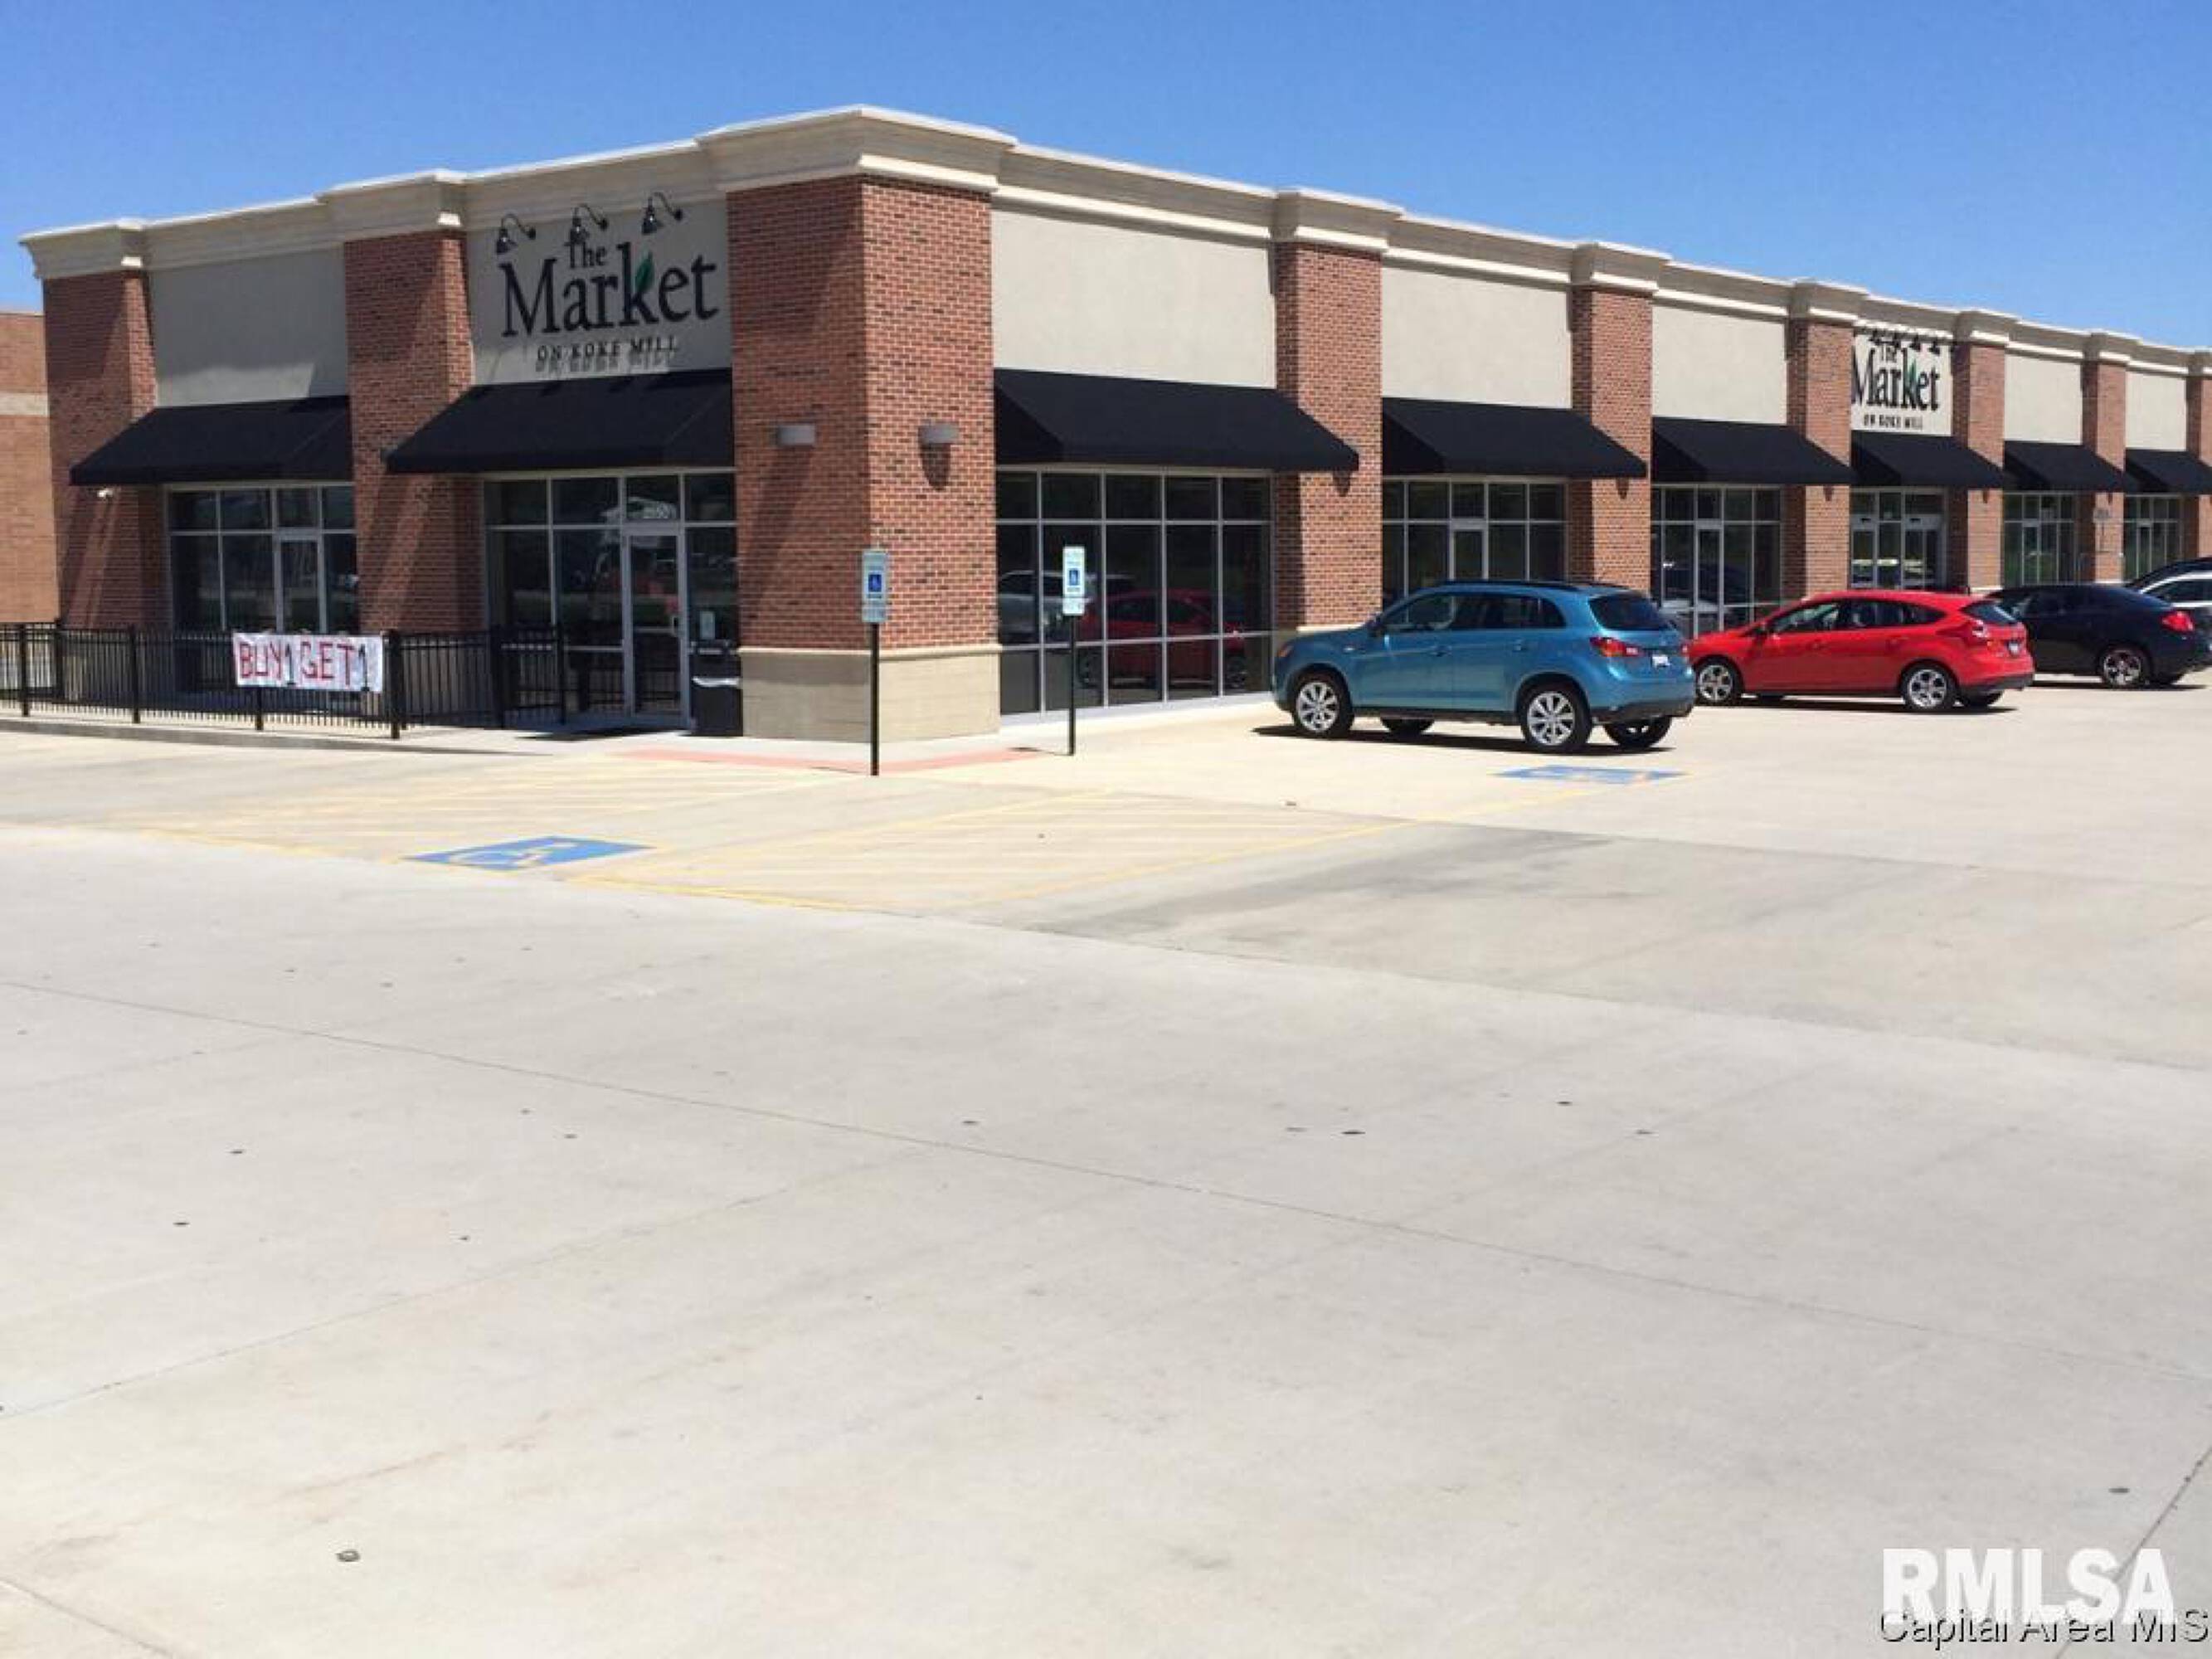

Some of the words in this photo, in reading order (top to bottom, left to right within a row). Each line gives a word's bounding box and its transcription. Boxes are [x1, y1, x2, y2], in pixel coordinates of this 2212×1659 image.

[564, 241, 607, 269] The
[499, 242, 719, 338] Market
[1851, 347, 1940, 411] Market
[240, 641, 282, 680] BUY
[300, 640, 355, 686] GET
